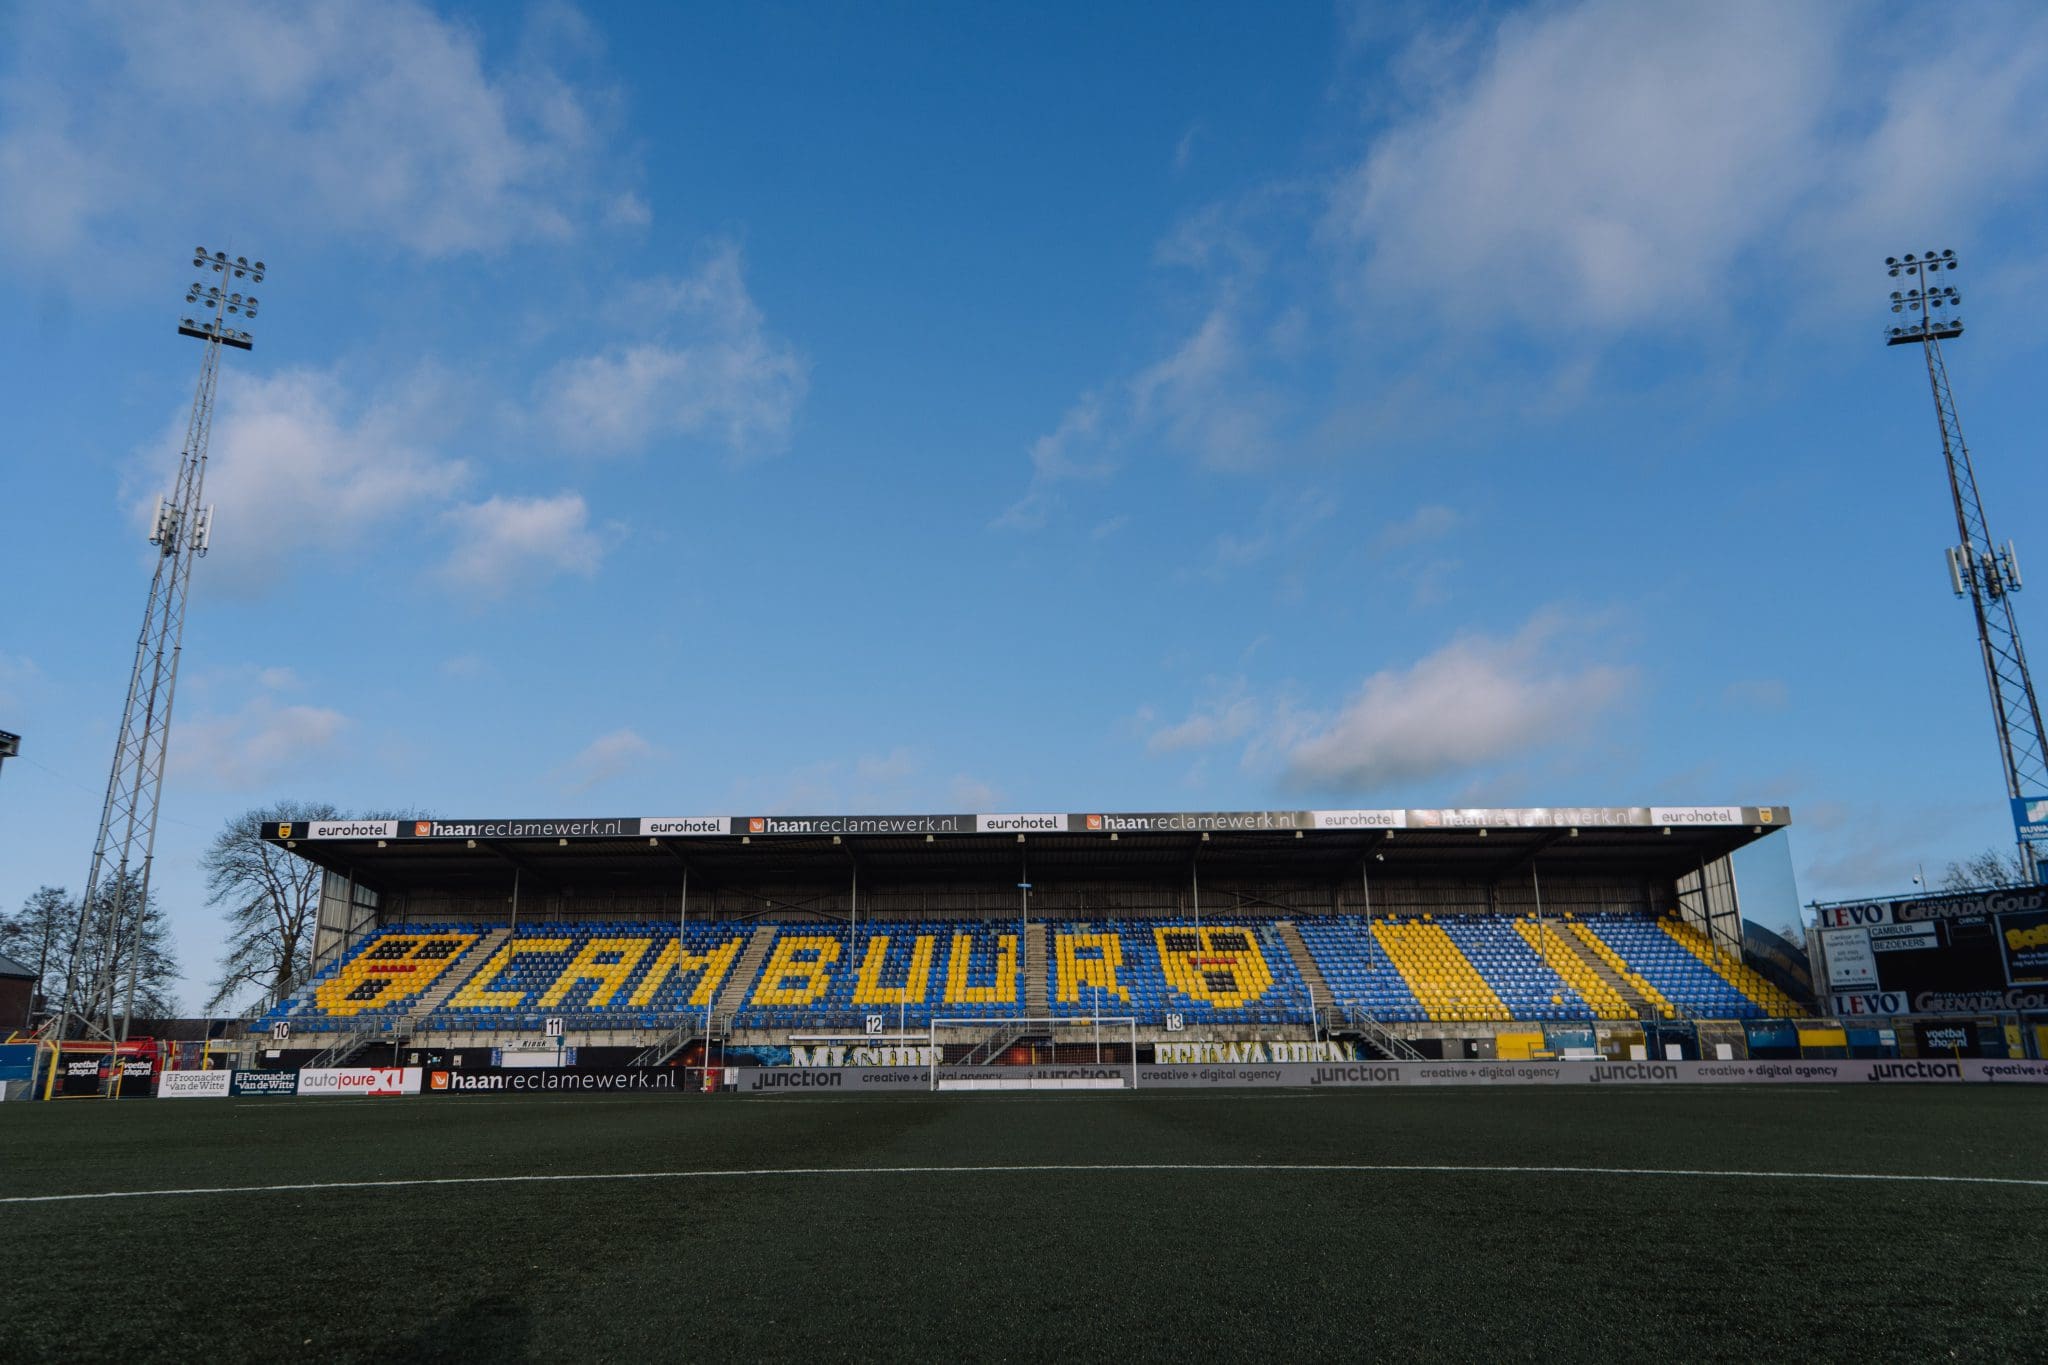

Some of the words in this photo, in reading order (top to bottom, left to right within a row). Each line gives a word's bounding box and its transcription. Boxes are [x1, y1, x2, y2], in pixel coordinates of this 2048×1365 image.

[986, 816, 1058, 830] eurohotel
[1103, 812, 1297, 830] haanreclamewerk.nl
[1324, 812, 1396, 827] eurohotel
[1661, 809, 1733, 823] eurohotel
[317, 822, 388, 837] eurohotel
[432, 819, 621, 837] haanreclamewerk.nl
[650, 819, 721, 833] eurohotel
[766, 817, 958, 833] haanreclamewerk.nl
[1821, 904, 1884, 928] LEVO
[1871, 925, 1913, 937] CAMBUUR
[1873, 938, 1926, 950] BEZOEKERS
[447, 933, 1132, 1006] CAMBUUR
[1833, 993, 1899, 1015] LEVO
[548, 1019, 561, 1035] 11
[868, 1017, 882, 1033] 12
[1167, 1015, 1183, 1030] 13
[275, 1023, 289, 1038] 10
[1925, 1028, 1965, 1039] voetbal
[1928, 1038, 1968, 1049] shonl
[68, 1060, 99, 1069] voetbal
[123, 1060, 153, 1069] voetbal
[1698, 1065, 1746, 1076] creative
[1755, 1064, 1793, 1078] digital
[1795, 1066, 1838, 1078] agency
[1868, 1061, 1962, 1082] junction
[1982, 1064, 2035, 1077] creative
[66, 1068, 99, 1077] shop.nl
[122, 1068, 152, 1077] shop.nl
[174, 1073, 225, 1082] Froonacker
[243, 1071, 296, 1081] Froonacker
[752, 1069, 842, 1090] junction
[862, 1072, 910, 1083] creative
[1141, 1069, 1189, 1080] creative
[1199, 1068, 1237, 1083] digital
[1239, 1070, 1281, 1083] agency
[1310, 1064, 1400, 1085] junction
[1420, 1067, 1468, 1078] creative
[1478, 1066, 1515, 1080] digital
[1518, 1067, 1560, 1080] agency
[1590, 1062, 1678, 1083] junction
[170, 1081, 188, 1090] Van
[189, 1081, 200, 1090] de
[200, 1081, 225, 1090] Witte
[240, 1081, 257, 1090] Van
[257, 1081, 268, 1090] de
[268, 1080, 295, 1089] Witte
[451, 1070, 676, 1091] haanreclamewerk.nl
